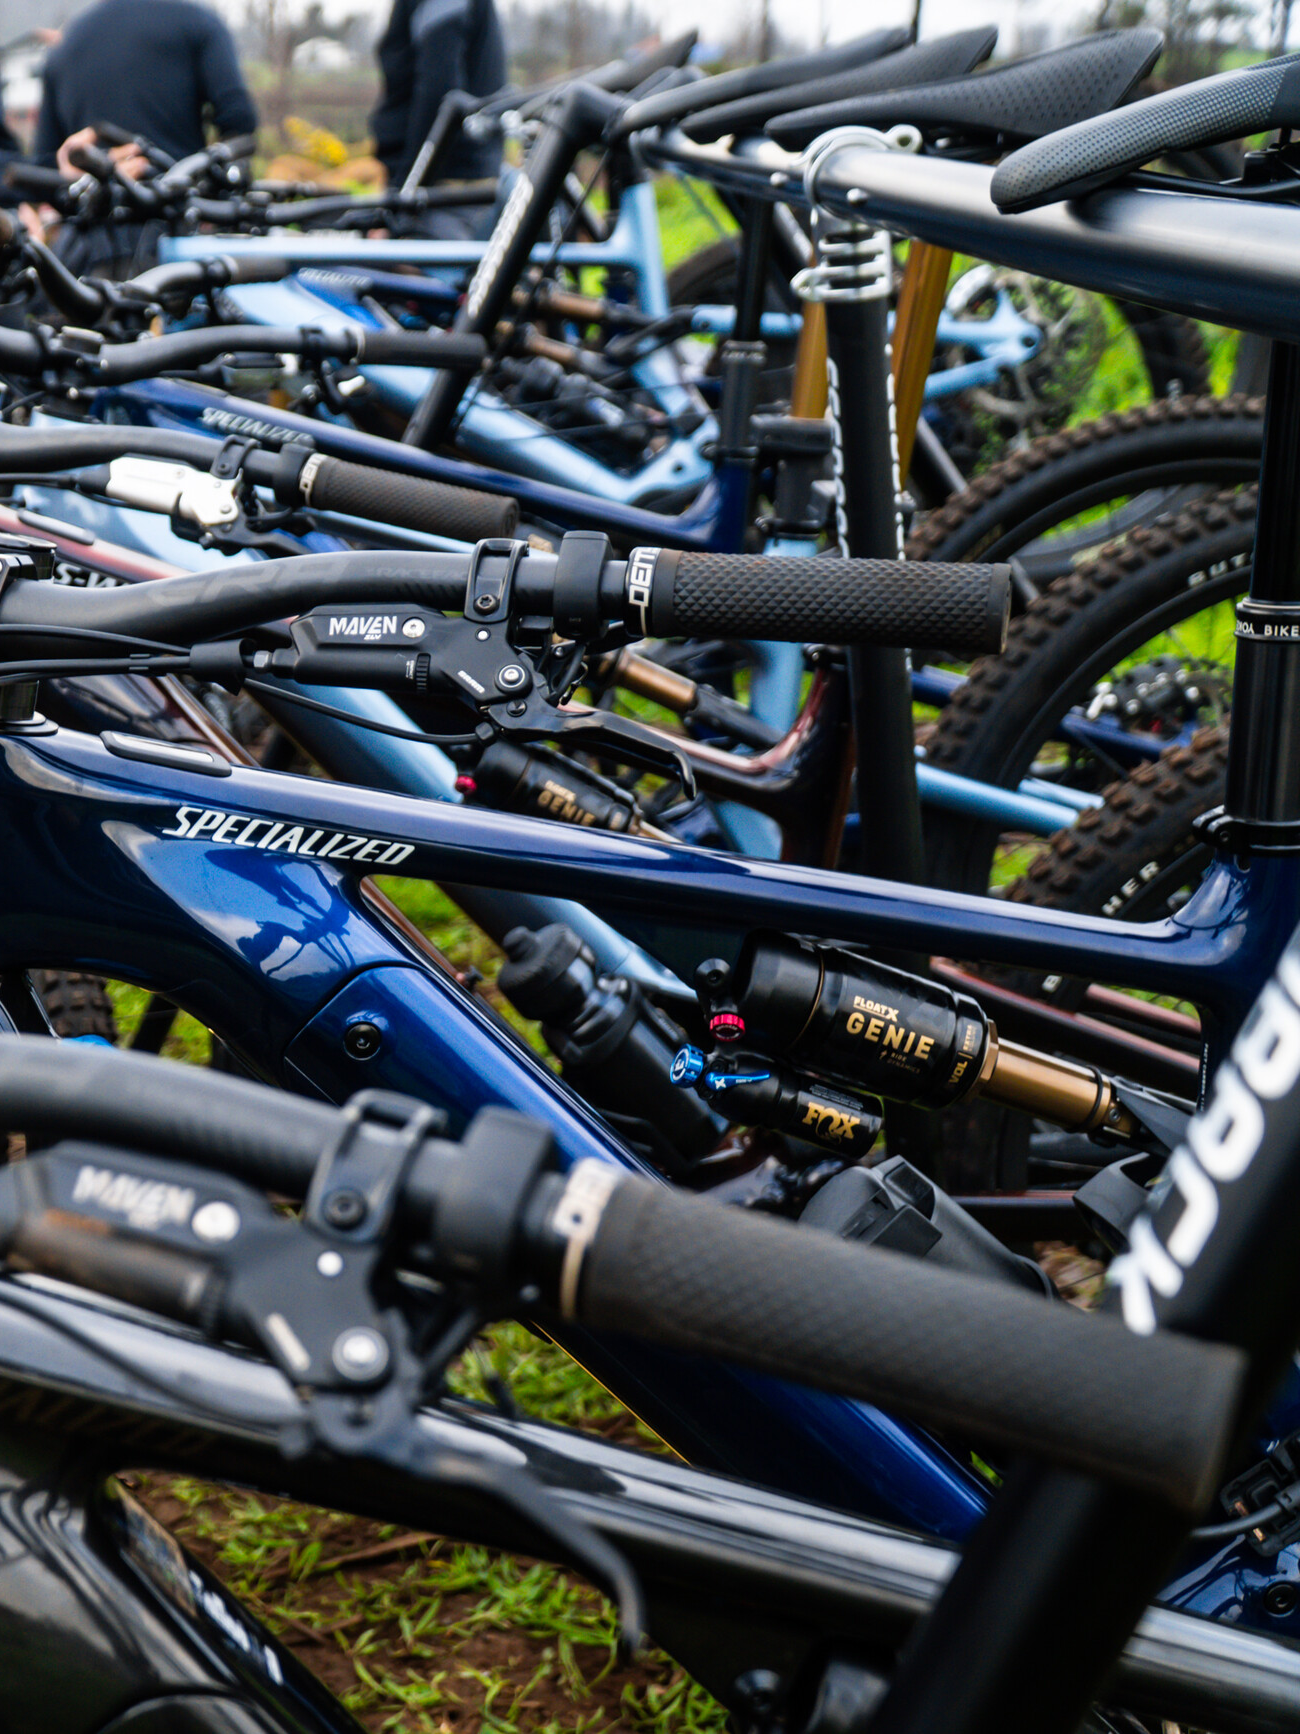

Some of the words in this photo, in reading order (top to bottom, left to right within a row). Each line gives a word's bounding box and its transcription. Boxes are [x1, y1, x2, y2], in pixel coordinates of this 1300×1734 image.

[1188, 552, 1256, 588] BUT
[329, 616, 398, 637] MAVEN
[1264, 624, 1300, 637] BIKE
[162, 806, 415, 865] SPECIALIZED
[846, 1012, 935, 1060] GENIE
[949, 1060, 968, 1083] VOL
[802, 1101, 860, 1144] FOX
[1106, 935, 1300, 1336] BACK
[72, 1165, 196, 1226] MAVEN
